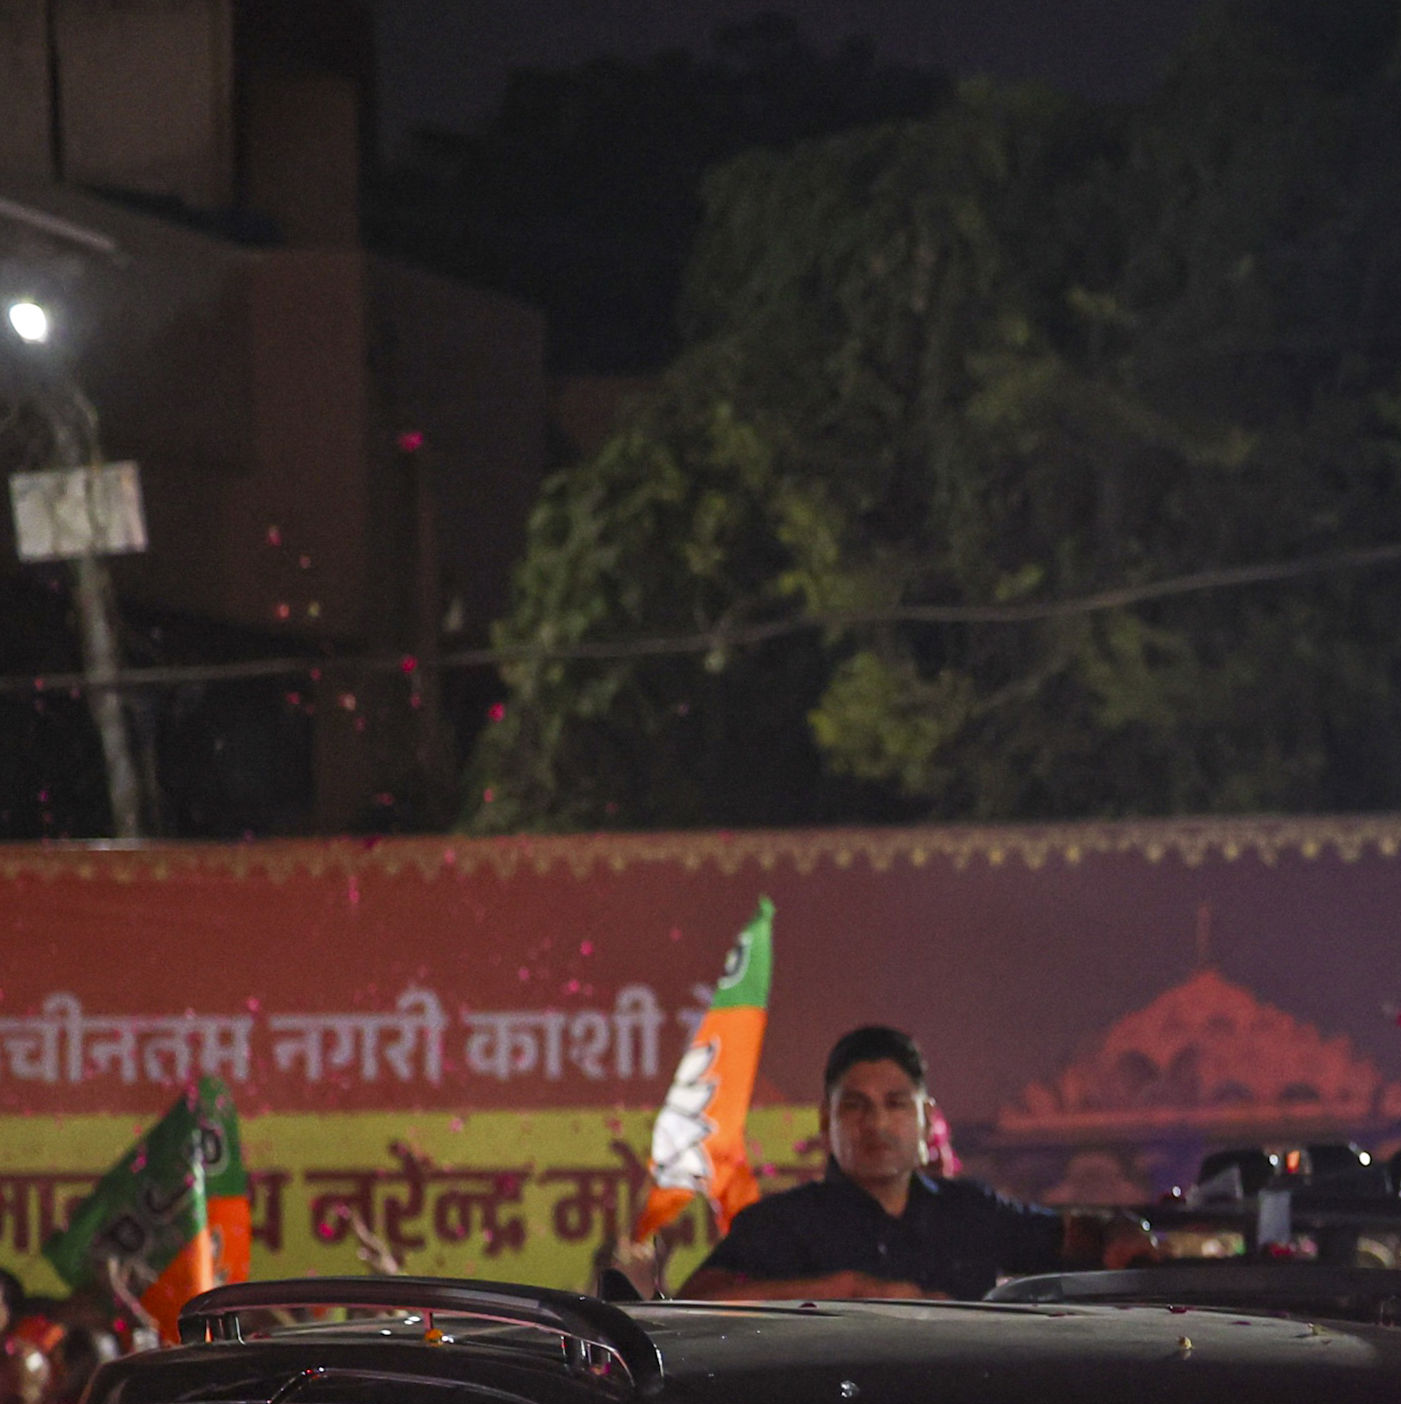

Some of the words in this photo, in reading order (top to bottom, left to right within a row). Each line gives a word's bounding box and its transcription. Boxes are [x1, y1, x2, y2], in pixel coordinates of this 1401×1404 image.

[269, 985, 449, 1083] नगरी
[465, 983, 662, 1083] काशी
[303, 1141, 532, 1257] नरेन्द्र
